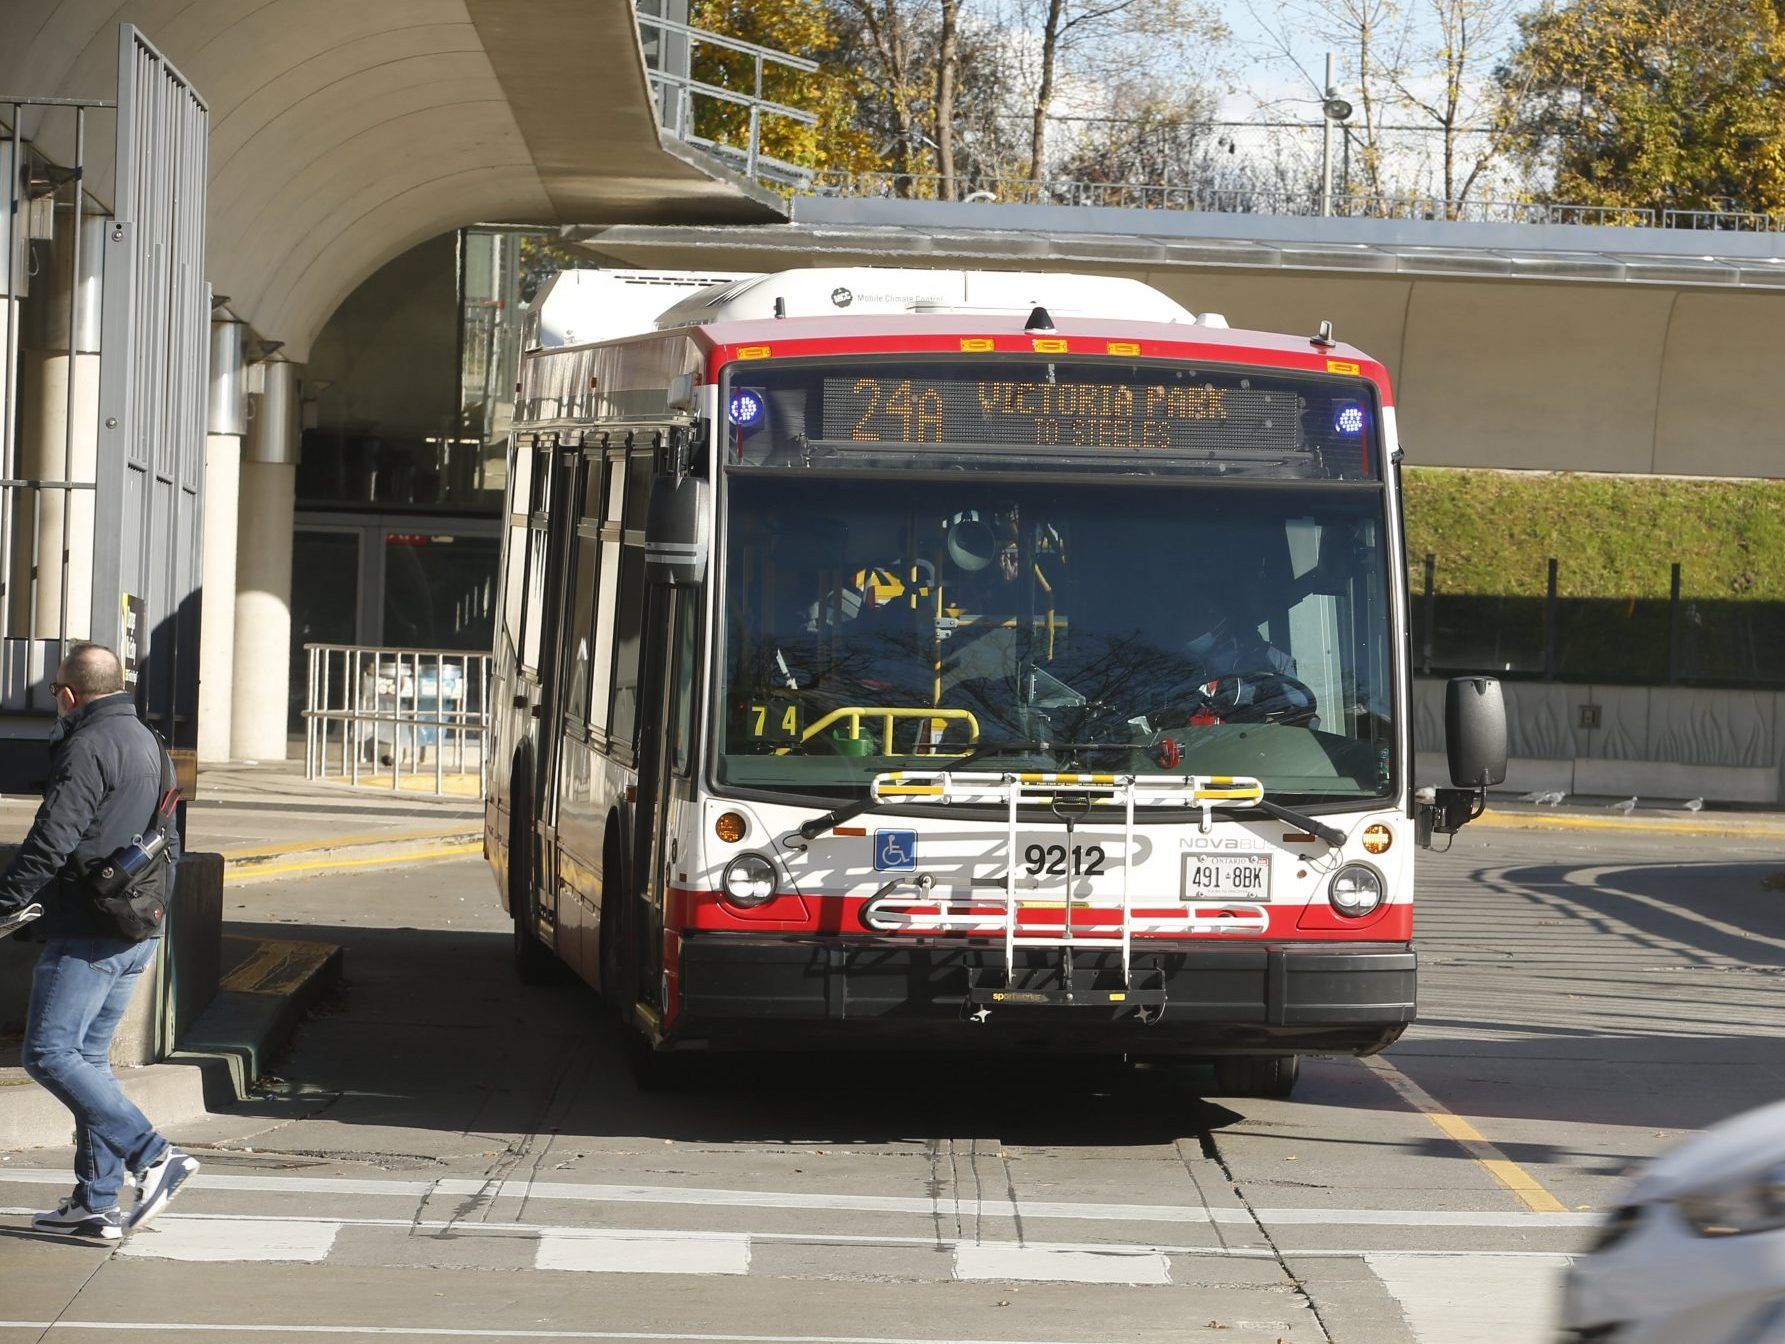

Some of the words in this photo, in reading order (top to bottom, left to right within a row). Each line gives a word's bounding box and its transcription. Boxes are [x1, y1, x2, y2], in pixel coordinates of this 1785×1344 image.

[857, 294, 883, 302] Mobile
[885, 294, 913, 303] Climate
[852, 378, 943, 443] 24A
[978, 382, 1133, 417] VICTORIA
[1147, 386, 1227, 420] PARK
[1034, 418, 1058, 446] TO
[1072, 419, 1170, 449] STEELES
[1024, 844, 1106, 876] 9212
[1211, 857, 1247, 865] ONTARIO
[1192, 866, 1220, 888] 491
[1232, 866, 1262, 888] 8BK
